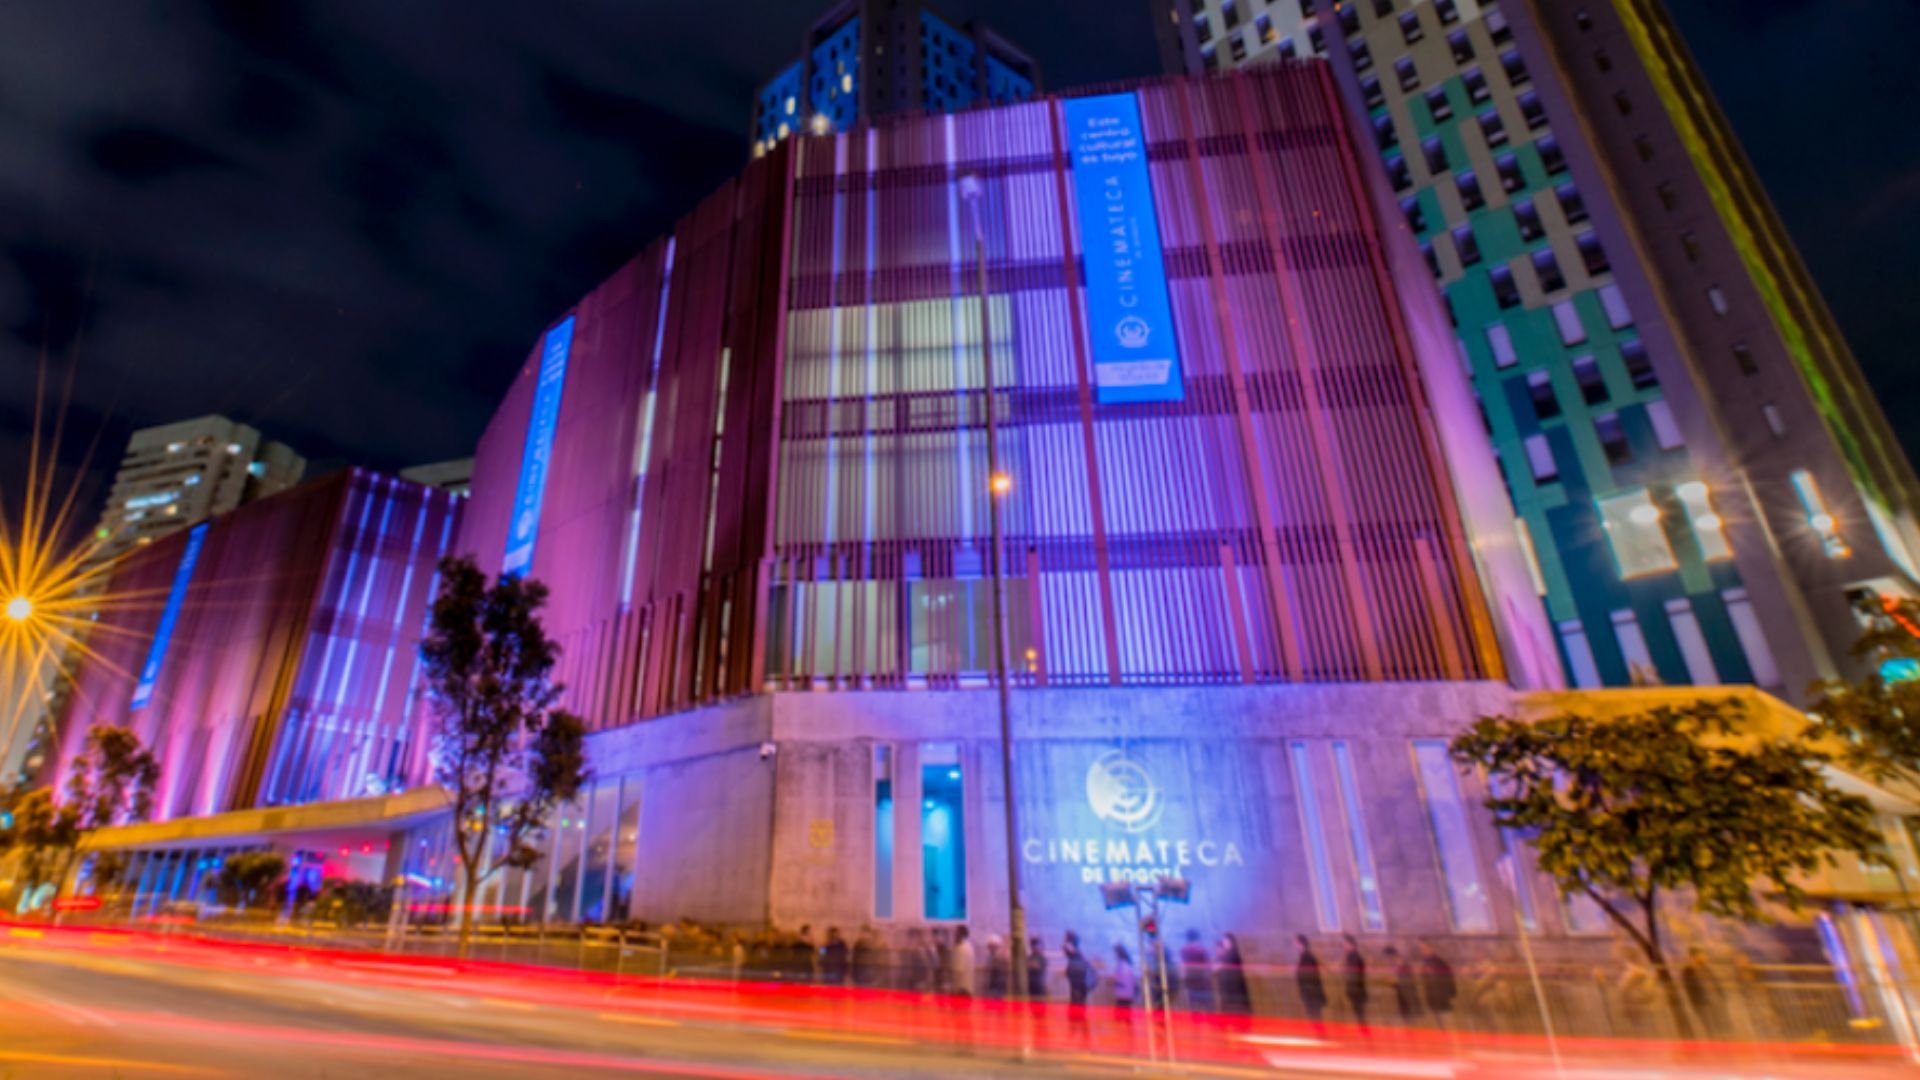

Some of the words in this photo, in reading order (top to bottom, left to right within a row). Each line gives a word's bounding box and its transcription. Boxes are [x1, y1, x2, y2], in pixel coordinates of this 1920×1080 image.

[1105, 176, 1138, 307] CINEMATECA
[1023, 839, 1243, 867] CINEMATECA
[1082, 867, 1103, 883] DE
